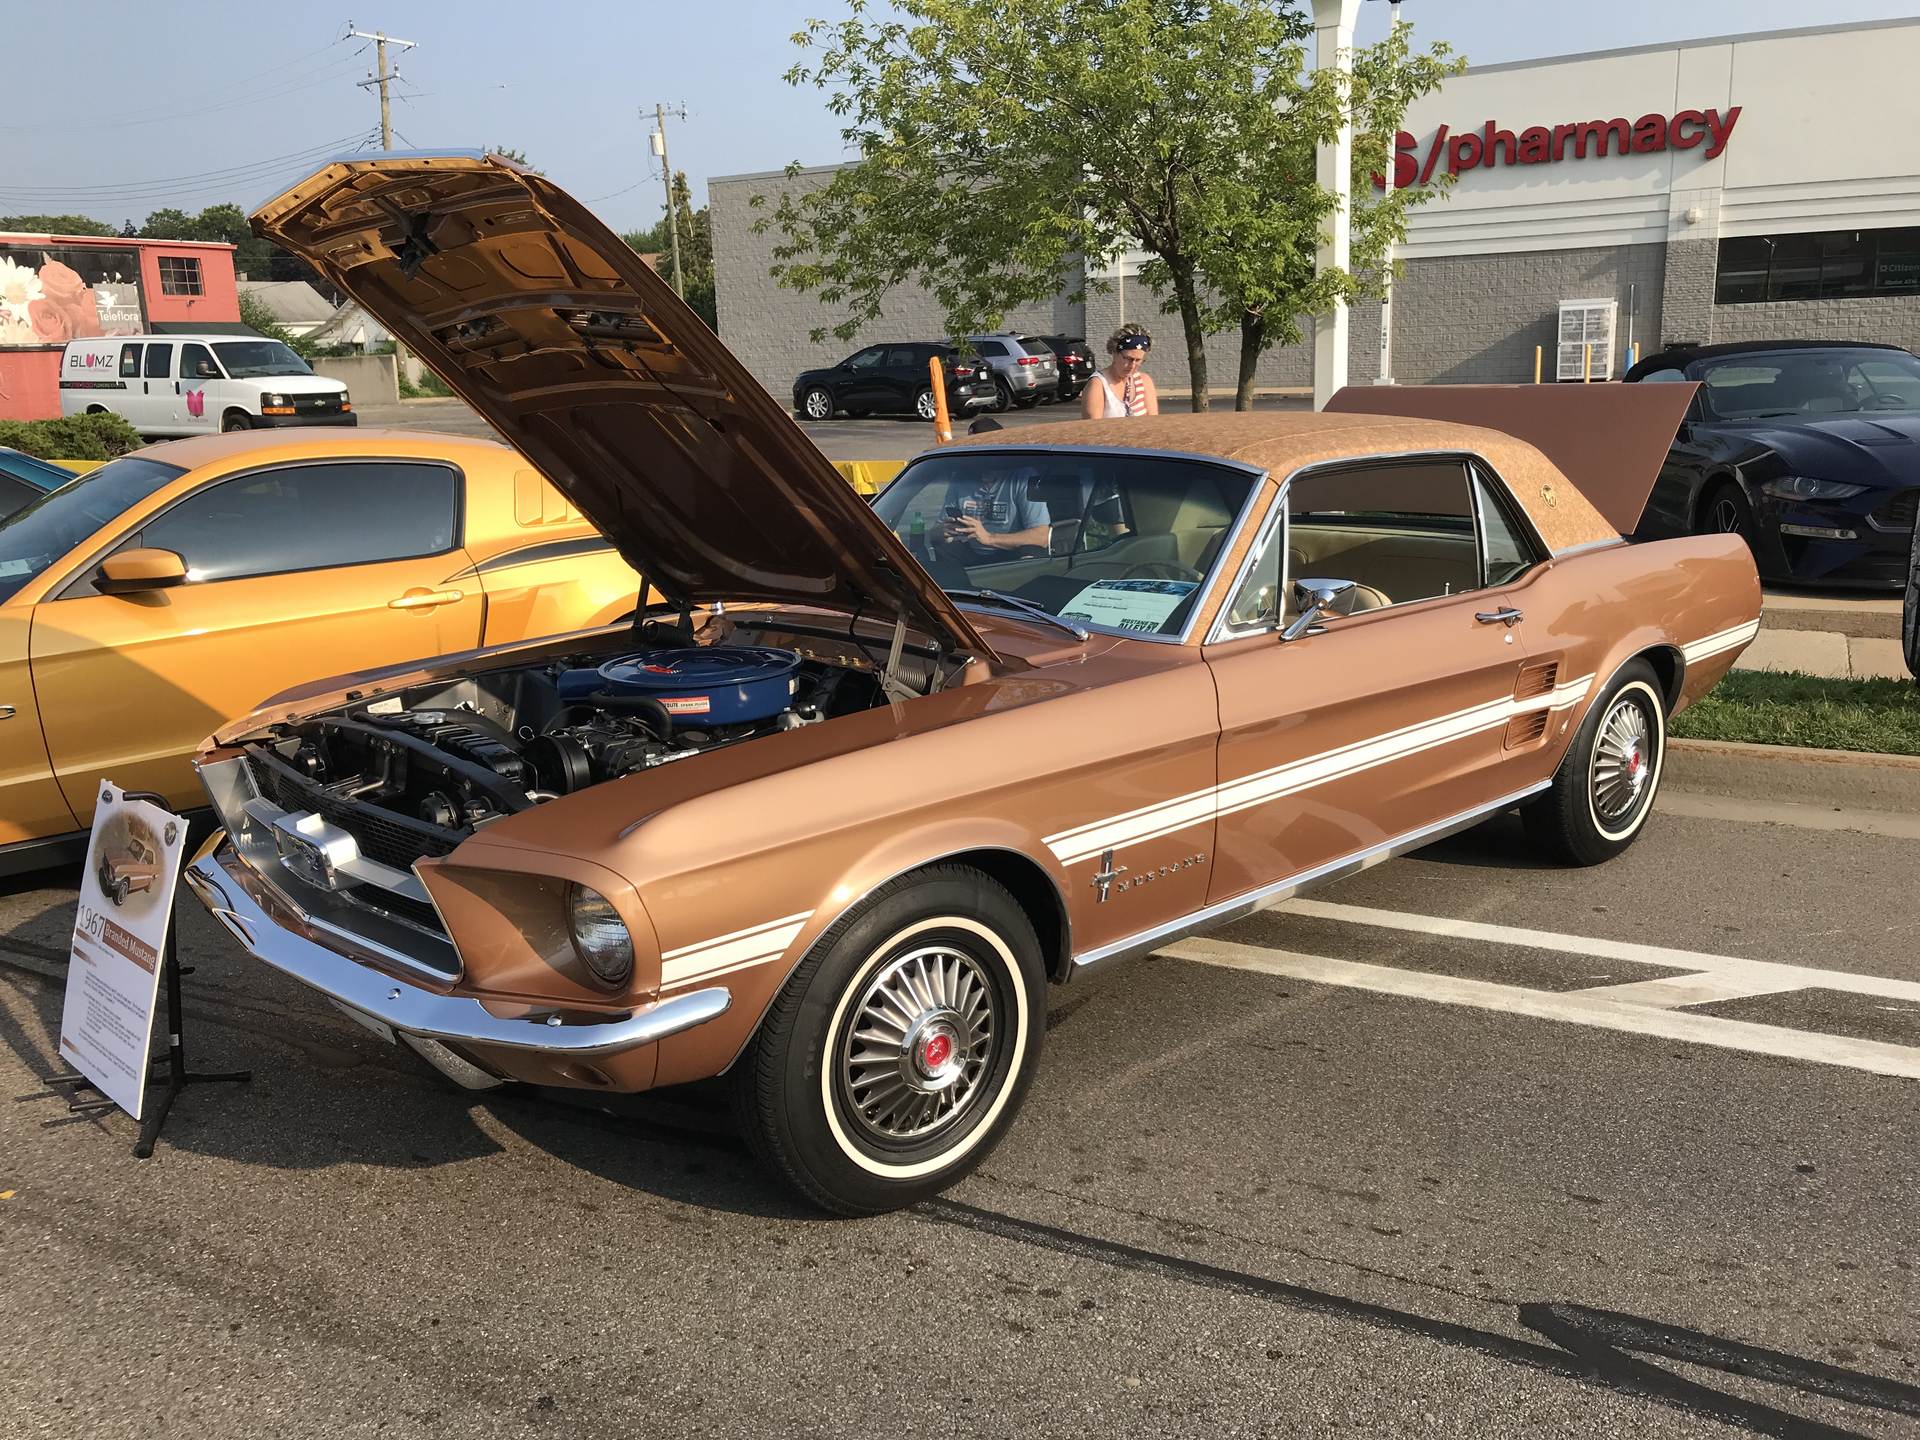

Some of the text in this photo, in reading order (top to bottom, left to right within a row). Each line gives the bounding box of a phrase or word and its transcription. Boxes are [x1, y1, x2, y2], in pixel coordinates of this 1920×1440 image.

[97, 310, 139, 321] Teleflora
[79, 903, 105, 938] 1967
[104, 923, 129, 950] Branded
[128, 939, 156, 970] Mustang
